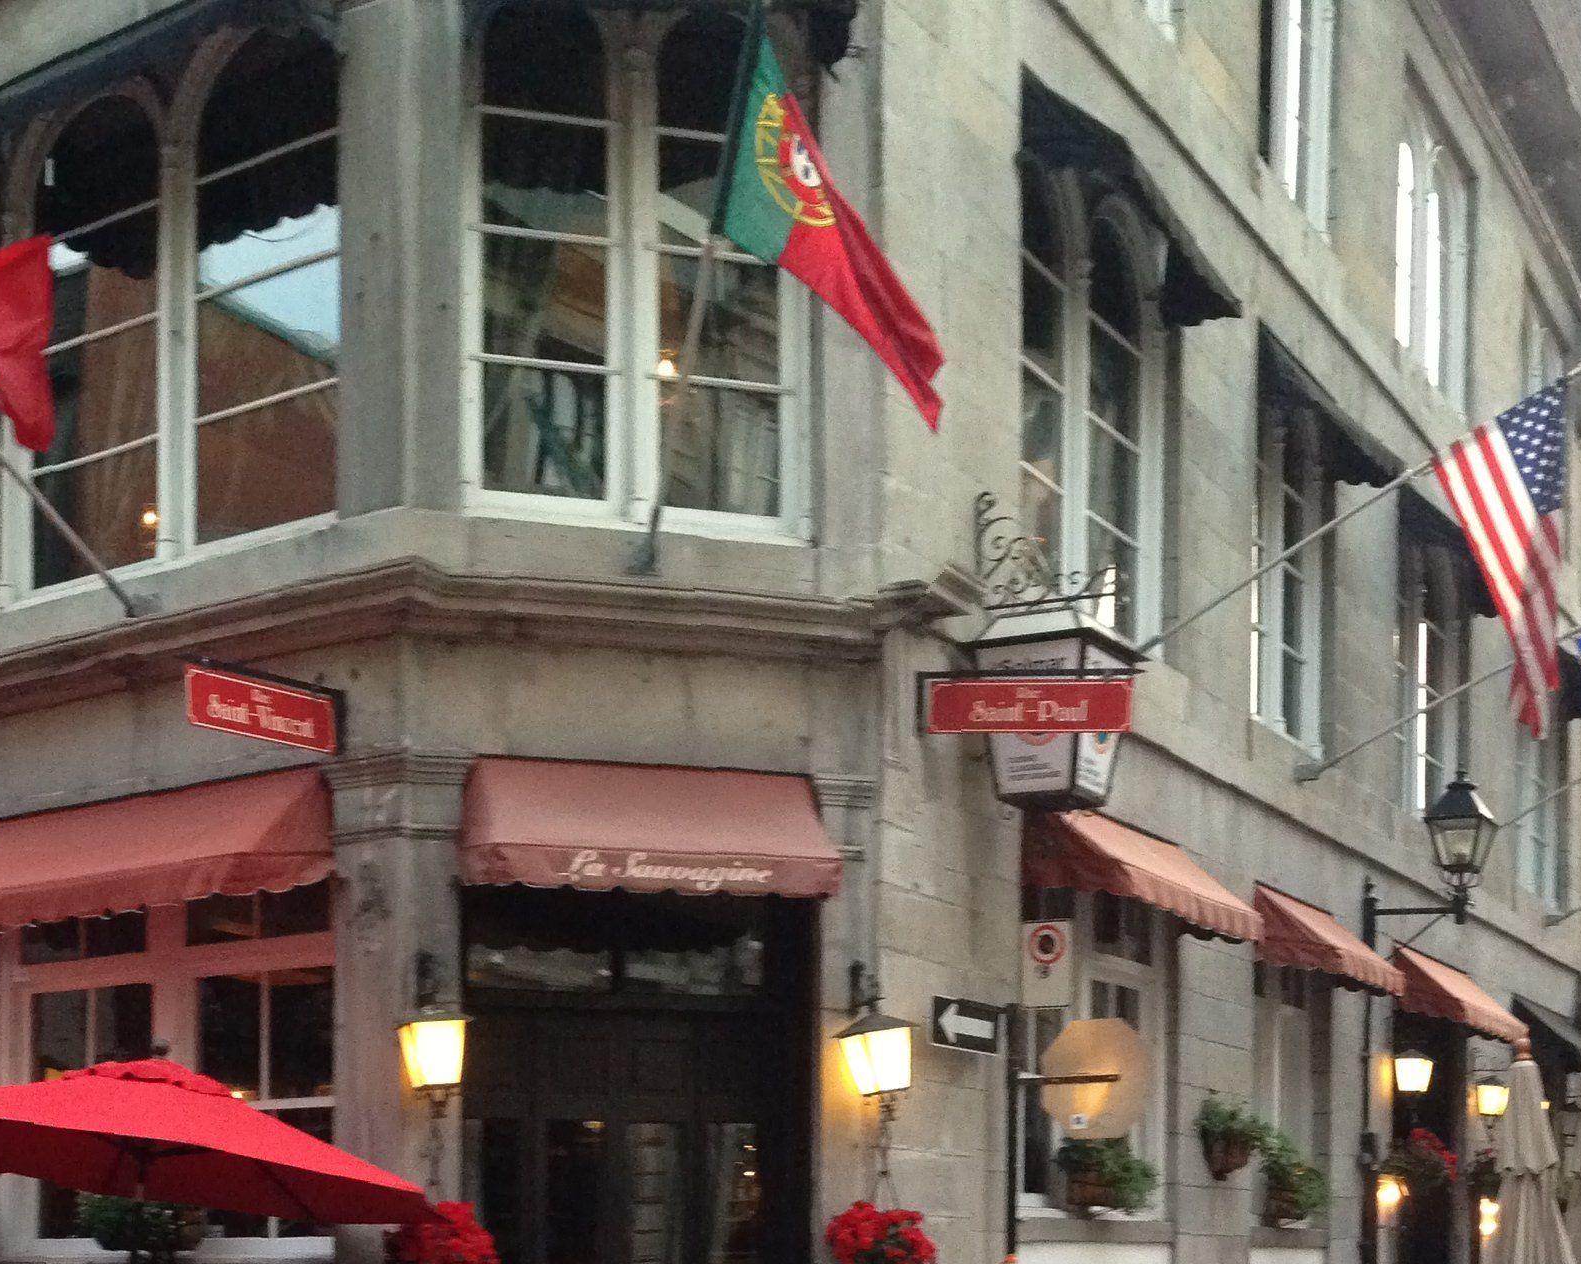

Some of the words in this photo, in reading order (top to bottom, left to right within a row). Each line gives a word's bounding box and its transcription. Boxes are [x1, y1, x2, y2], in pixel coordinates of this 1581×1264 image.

[207, 694, 315, 738] Saint-Vincent
[969, 700, 1088, 722] Saint-Paul
[611, 852, 773, 892] Sauvagine
